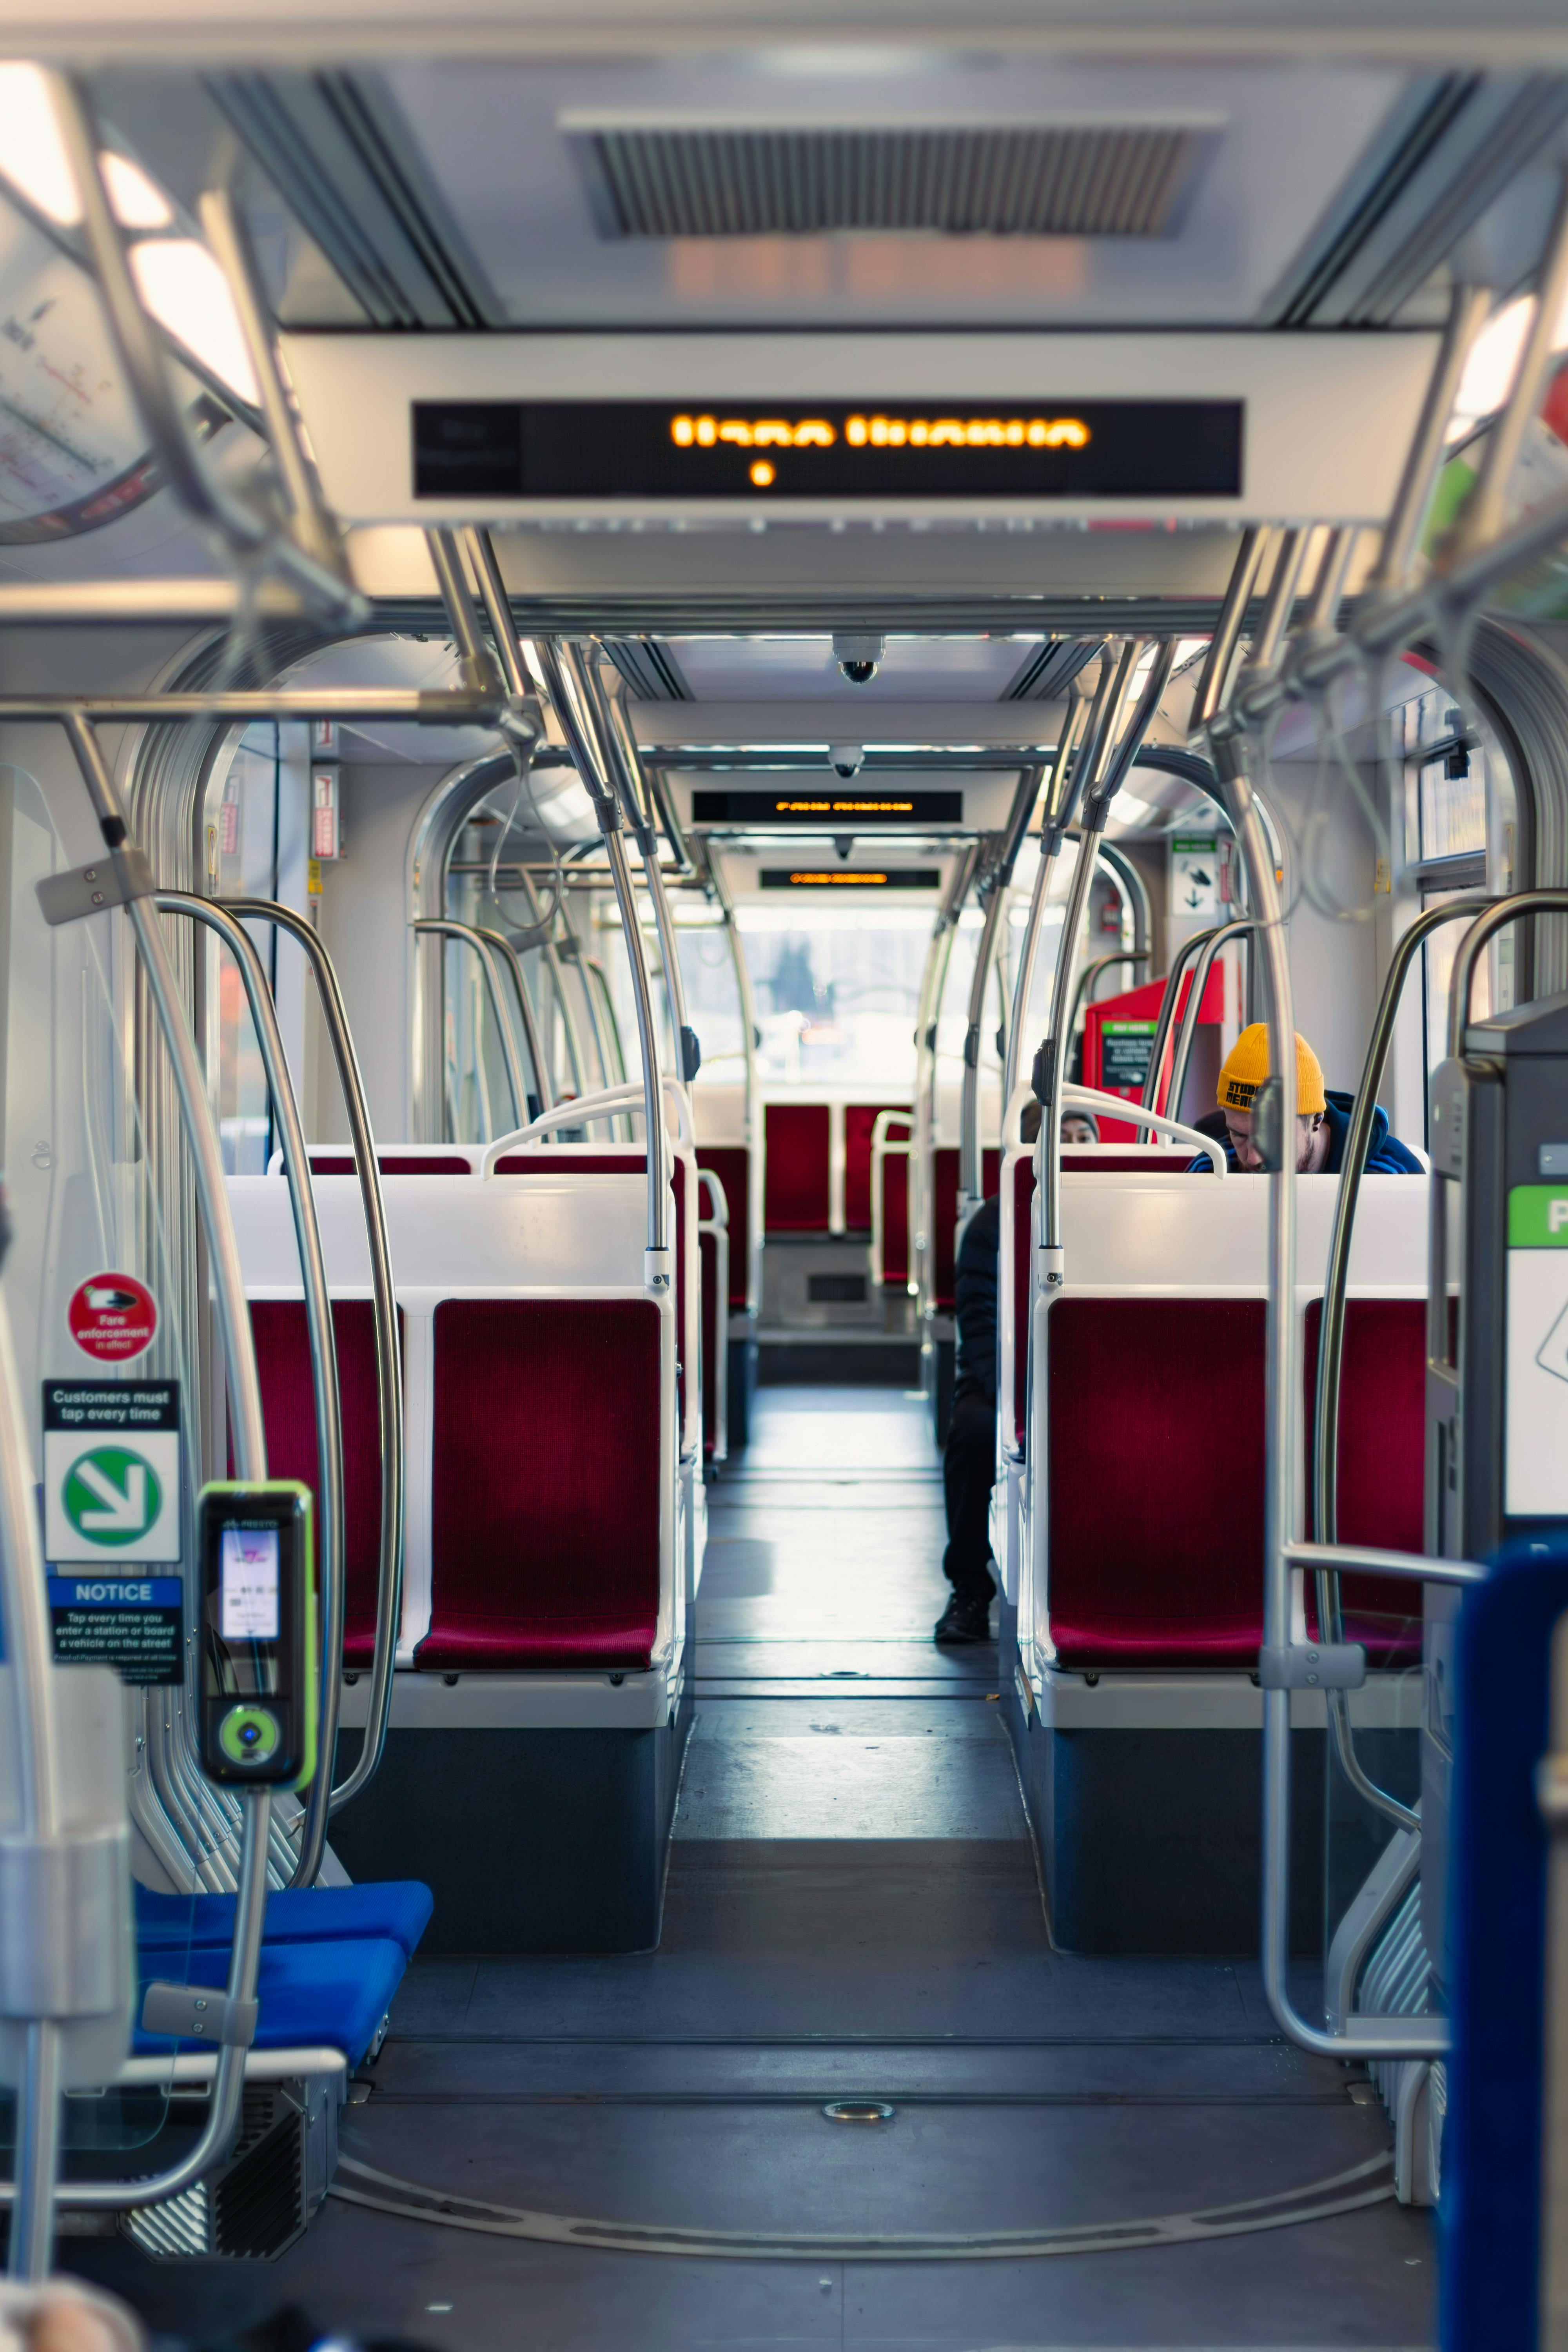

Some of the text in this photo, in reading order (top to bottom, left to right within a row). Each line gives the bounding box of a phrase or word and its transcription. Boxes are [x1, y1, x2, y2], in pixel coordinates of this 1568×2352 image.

[100, 1315, 126, 1325] Fare
[77, 1328, 149, 1339] enforcement
[96, 1340, 131, 1349] in effect
[53, 1390, 169, 1404] Customers must
[61, 1407, 161, 1423] tap every time
[76, 1584, 152, 1601] NOTICE
[68, 1612, 162, 1624] Tap every time you
[56, 1627, 83, 1635] enter
[93, 1626, 128, 1635] station
[144, 1626, 175, 1635] board
[68, 1639, 105, 1648] vehicle
[122, 1639, 139, 1648] the
[141, 1639, 172, 1648] street
